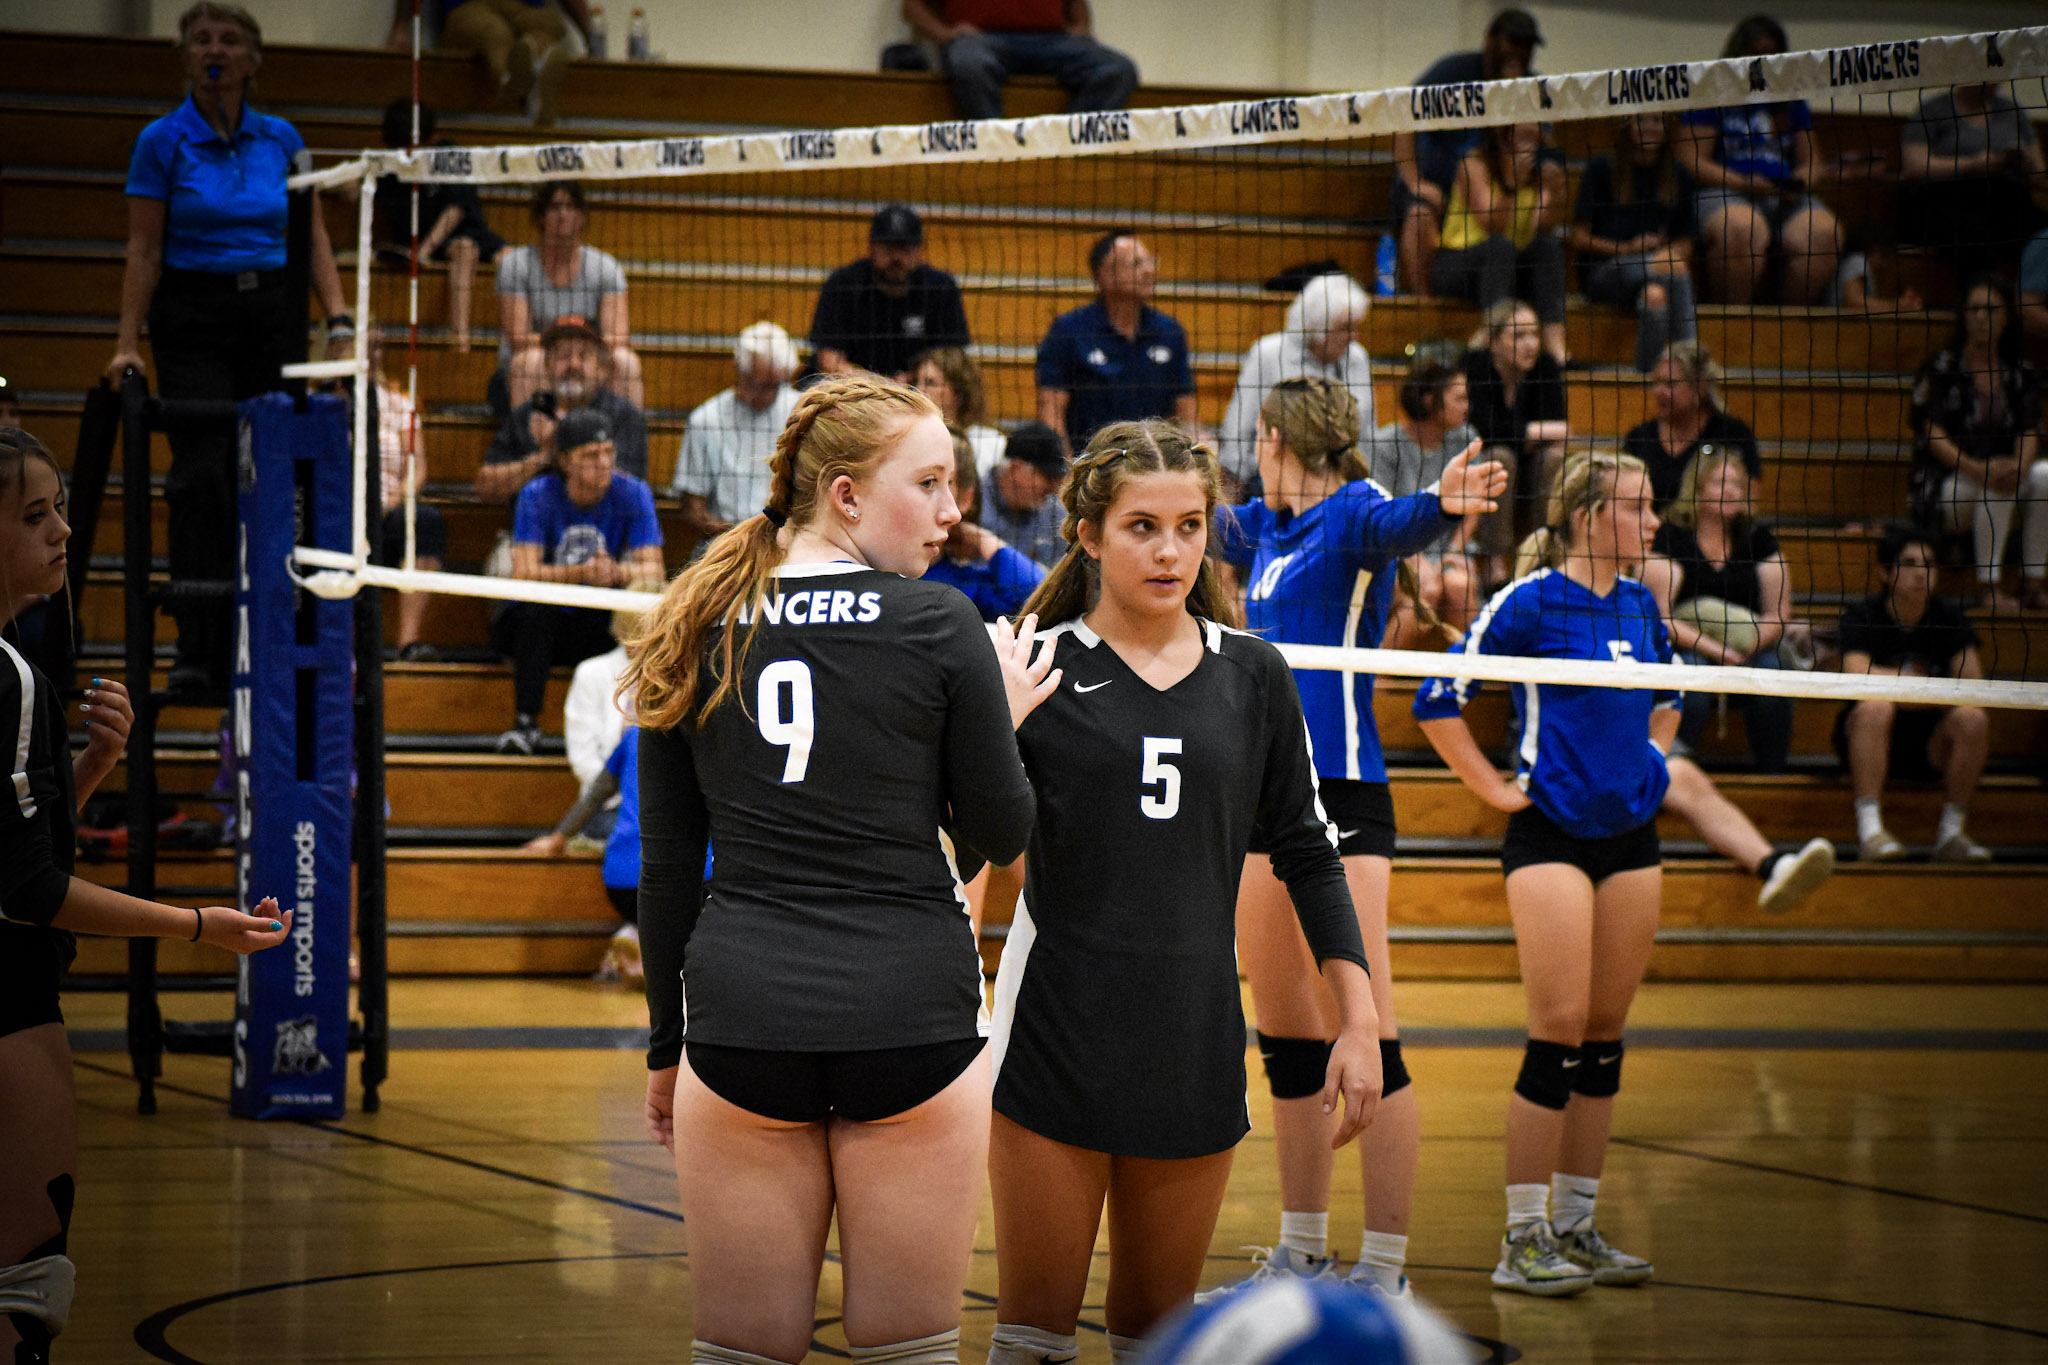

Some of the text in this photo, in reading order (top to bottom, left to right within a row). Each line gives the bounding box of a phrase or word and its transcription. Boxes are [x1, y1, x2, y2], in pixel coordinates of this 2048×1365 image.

[1608, 64, 1690, 105] LANCERS
[1829, 40, 1919, 87] LANCERS
[1231, 99, 1299, 134] LANCERS
[1411, 84, 1486, 120] LANCERS
[715, 590, 883, 625] ANCERS
[757, 659, 816, 784] 9
[1140, 736, 1183, 820] 5
[293, 821, 315, 997] sports imports
